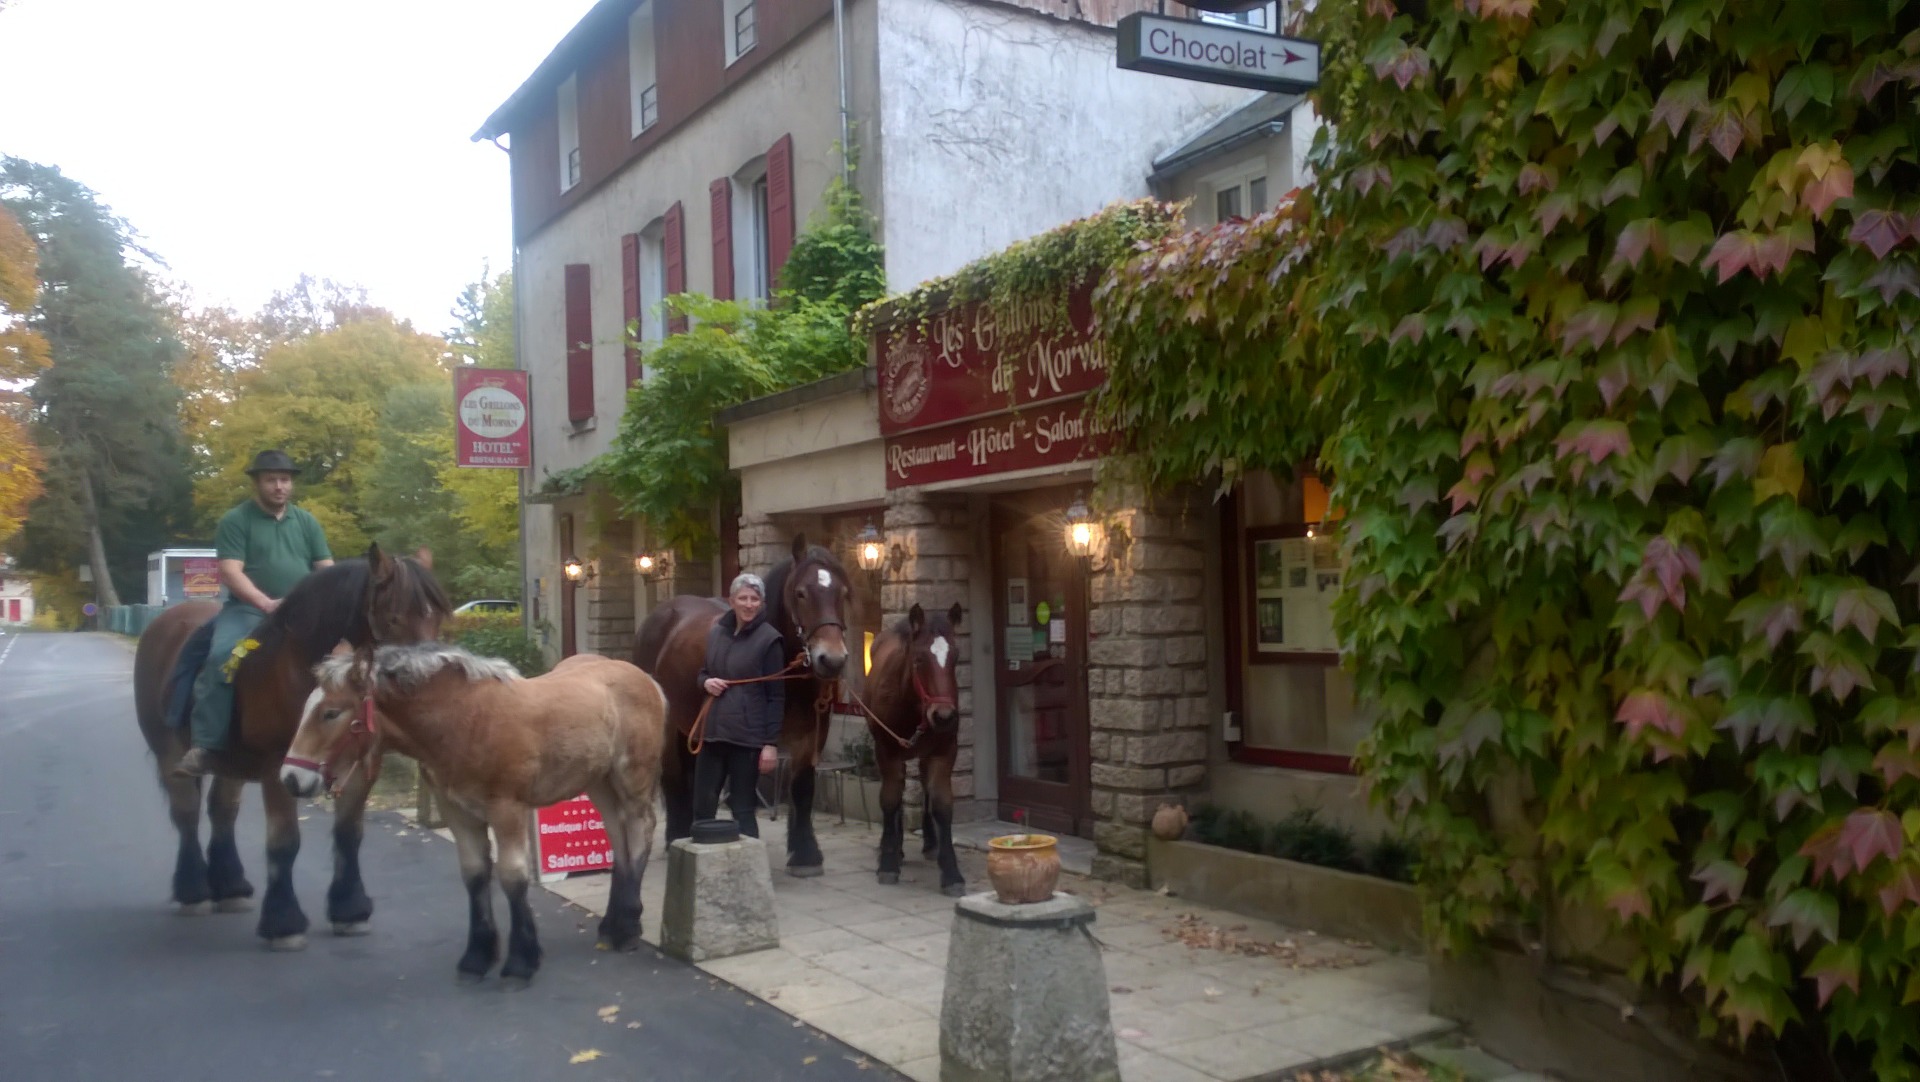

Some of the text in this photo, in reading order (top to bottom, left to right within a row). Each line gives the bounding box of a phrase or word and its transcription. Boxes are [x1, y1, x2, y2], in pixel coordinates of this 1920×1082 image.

[1150, 27, 1267, 70] Chocolat
[933, 313, 964, 368] Les
[887, 443, 956, 479] Restaurant
[967, 420, 1015, 466] Hôtel
[1034, 411, 1084, 454] Salon
[540, 823, 582, 834] Boutique
[547, 854, 585, 869] Salon
[586, 851, 602, 865] de
